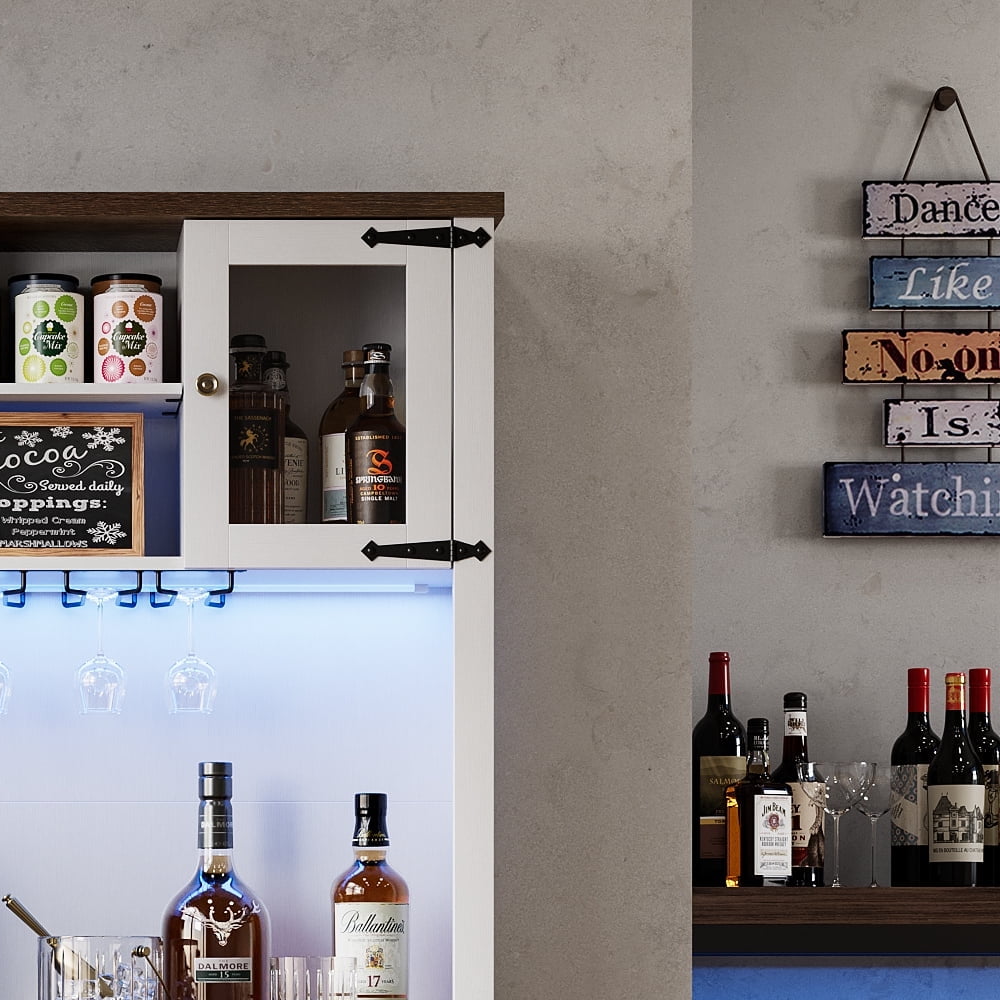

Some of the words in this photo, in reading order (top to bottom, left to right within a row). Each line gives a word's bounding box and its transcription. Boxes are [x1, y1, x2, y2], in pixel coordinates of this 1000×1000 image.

[889, 193, 1000, 223] Dance
[897, 262, 993, 300] Like
[34, 331, 66, 343] Cupcake
[112, 331, 145, 343] Cupcake
[45, 341, 63, 350] Mix
[124, 341, 142, 350] Mix
[878, 339, 934, 373] No
[920, 407, 970, 438] Is
[39, 479, 87, 491] Served
[88, 480, 125, 497] daily
[839, 475, 1000, 518] Watchi
[0, 516, 49, 525] Whipped
[52, 516, 87, 525] Cream
[11, 528, 76, 537] Peppermint
[761, 804, 772, 817] JIM
[772, 801, 786, 817] BEAM
[341, 909, 405, 934] Ballantine's
[198, 962, 249, 970] DALMORE
[220, 970, 230, 978] 15
[367, 975, 381, 988] 17
